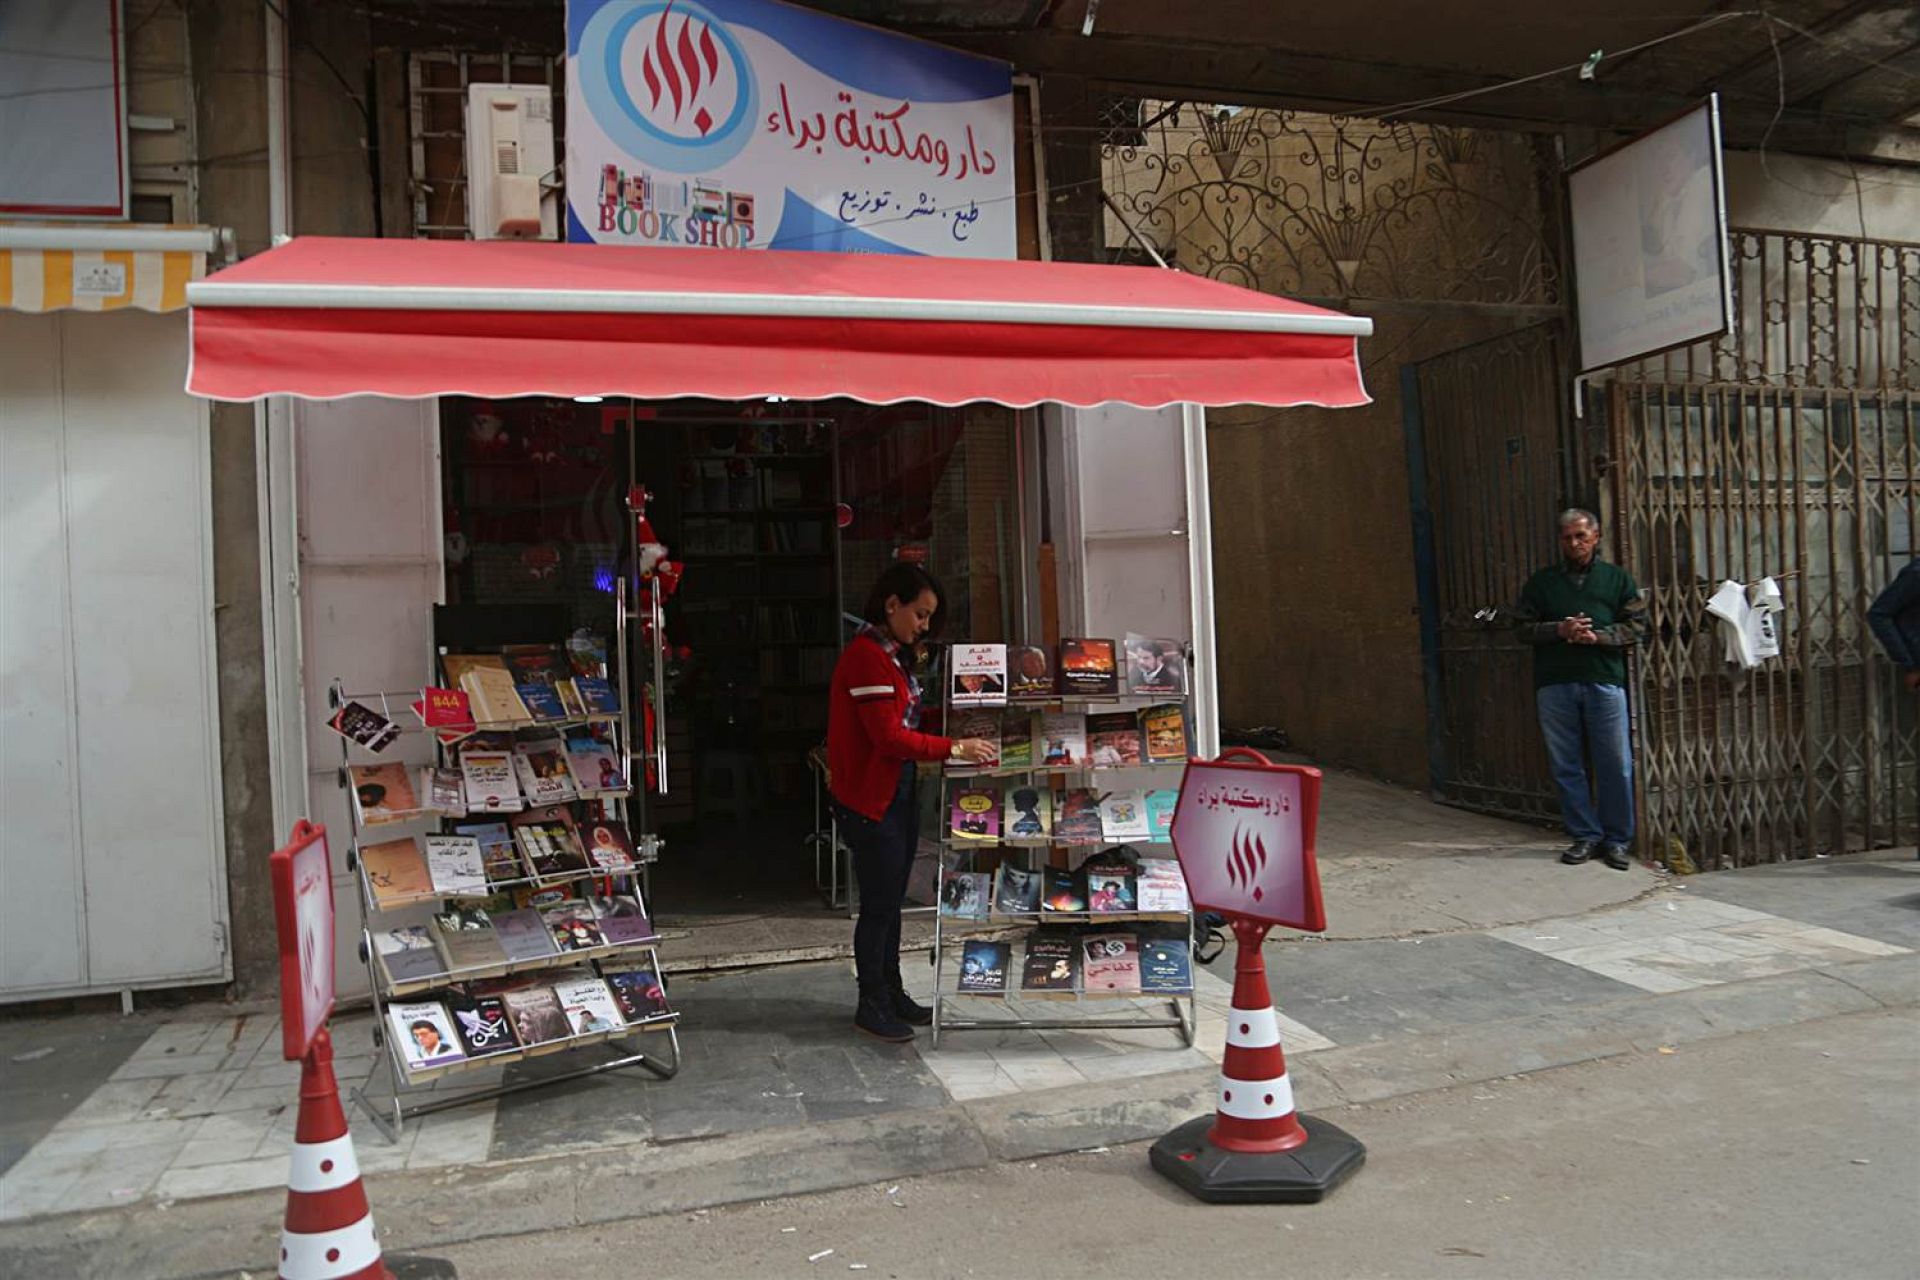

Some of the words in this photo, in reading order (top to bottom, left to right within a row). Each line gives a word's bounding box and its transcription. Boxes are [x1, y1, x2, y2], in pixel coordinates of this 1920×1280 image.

[767, 82, 827, 155] براء
[954, 124, 997, 180] دار
[597, 199, 680, 244] BOOK
[684, 215, 756, 250] SHOP
[839, 190, 892, 223] توزيع
[904, 192, 936, 221] نشر
[952, 201, 980, 241] طبع
